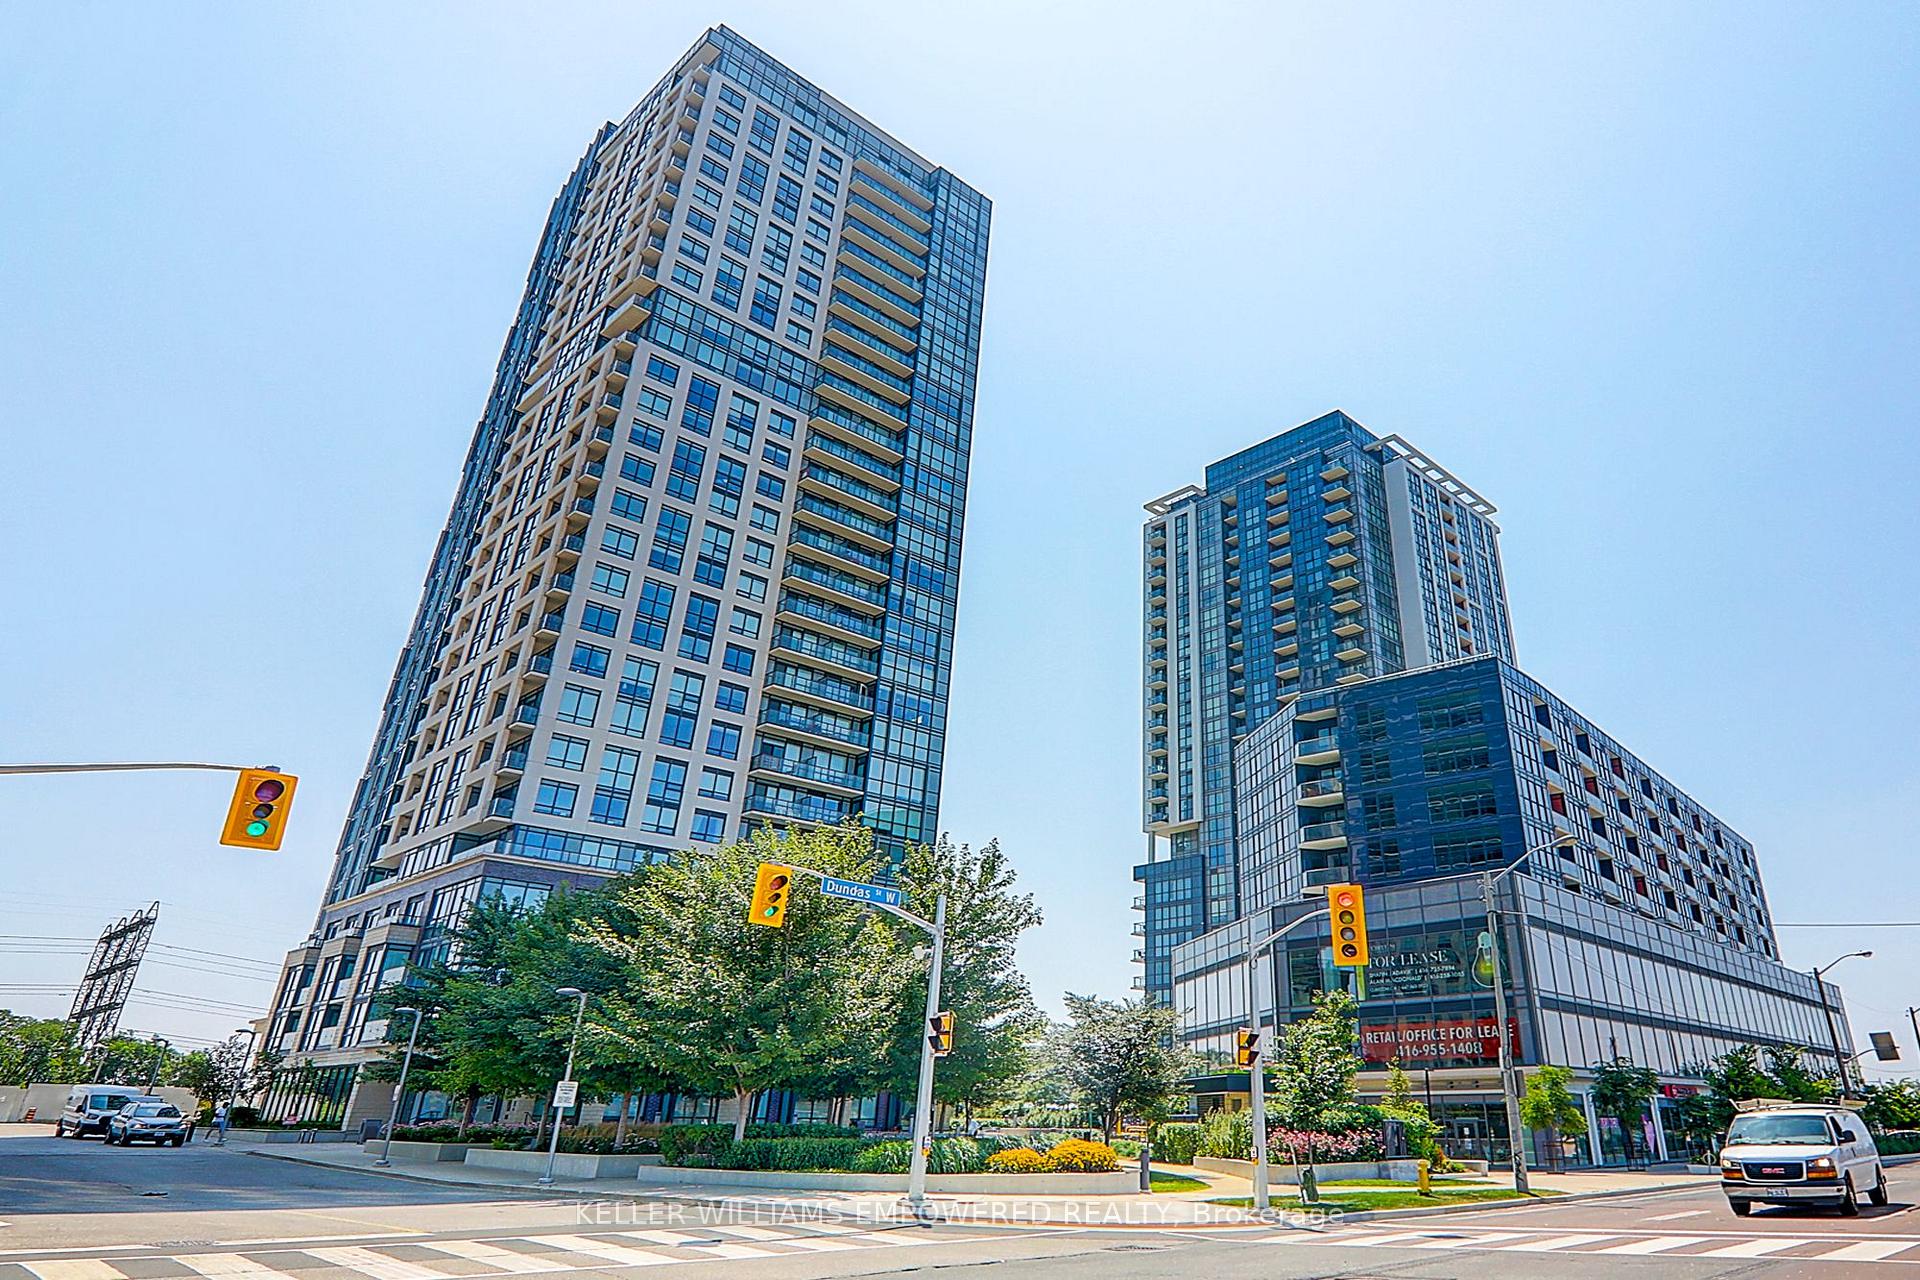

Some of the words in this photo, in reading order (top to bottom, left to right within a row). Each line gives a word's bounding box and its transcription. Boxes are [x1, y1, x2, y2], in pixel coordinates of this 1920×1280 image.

[827, 880, 871, 899] Dundas
[886, 891, 896, 903] W
[1369, 955, 1396, 969] FOR
[1400, 949, 1449, 966] LEASE
[1366, 1027, 1447, 1044] RETAIL/OFFICE
[1450, 1025, 1473, 1040] FOR
[1477, 1023, 1514, 1038] LEAE
[1396, 1041, 1483, 1057] 416-955-1408
